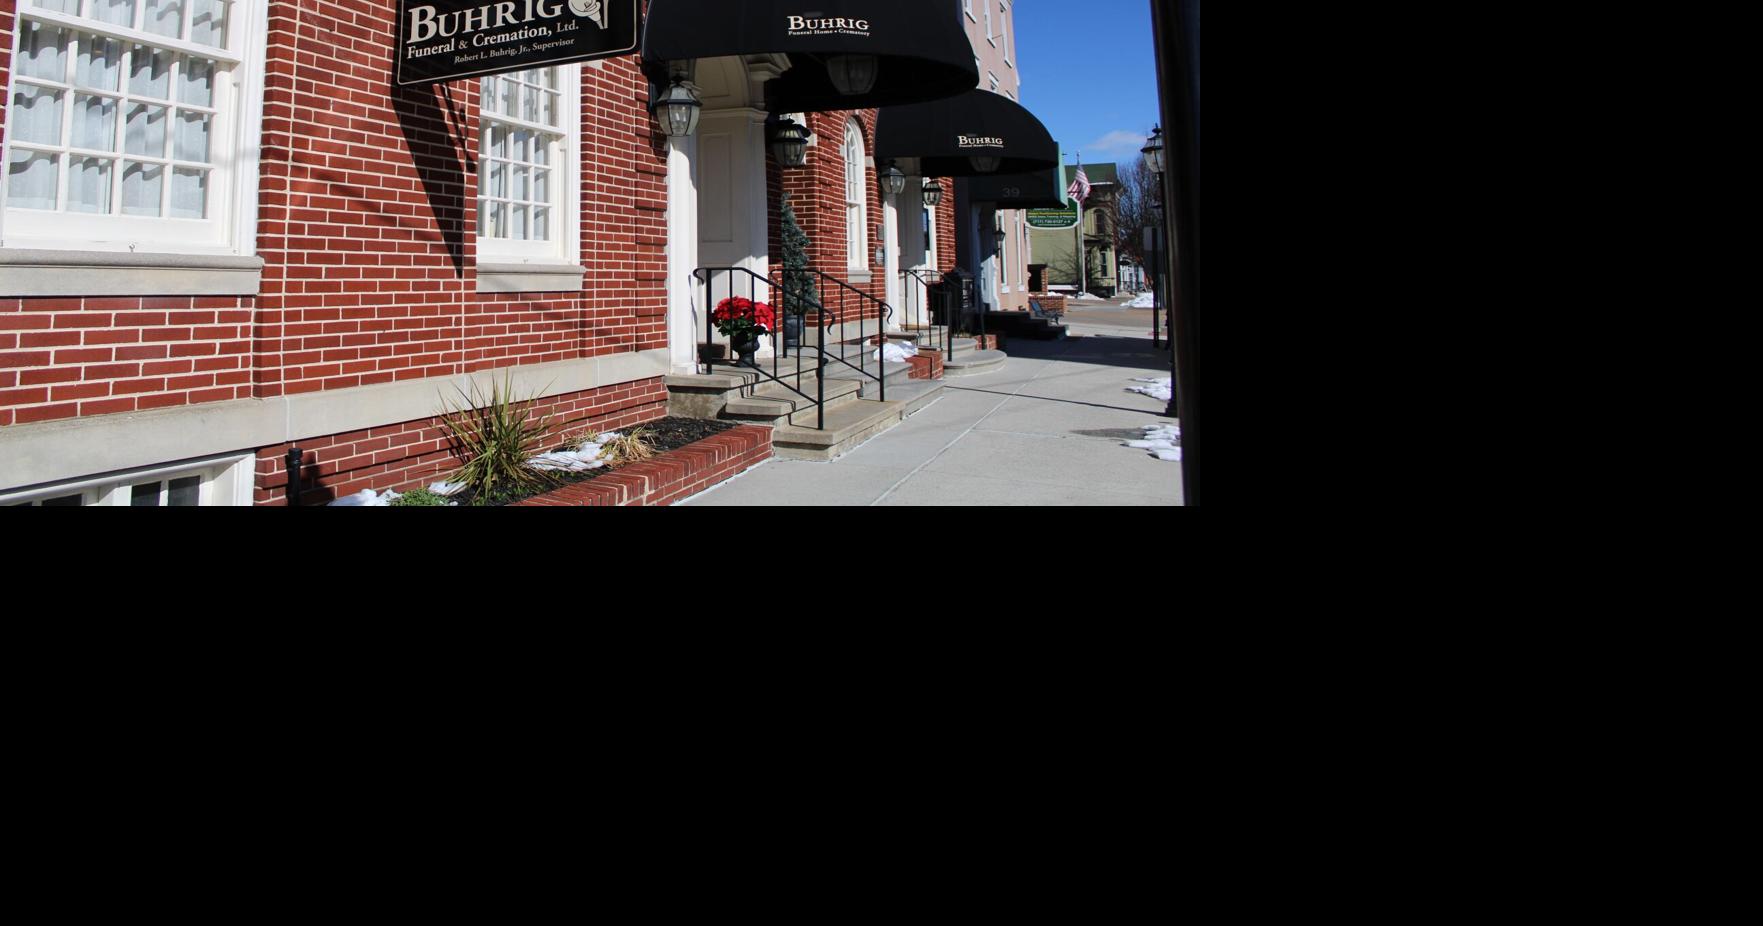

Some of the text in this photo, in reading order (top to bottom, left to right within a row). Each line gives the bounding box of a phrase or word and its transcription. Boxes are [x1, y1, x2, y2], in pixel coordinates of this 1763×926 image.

[406, 0, 564, 44] BUHRIG
[787, 15, 869, 30] BUHRIG
[407, 20, 579, 59] Funeral & Cremation, Ltd.
[454, 53, 479, 64] Robert
[489, 47, 517, 58] Buhrig,
[532, 38, 575, 52] Supervisor
[958, 135, 1003, 145] BUHRIG
[1002, 187, 1020, 198] 39
